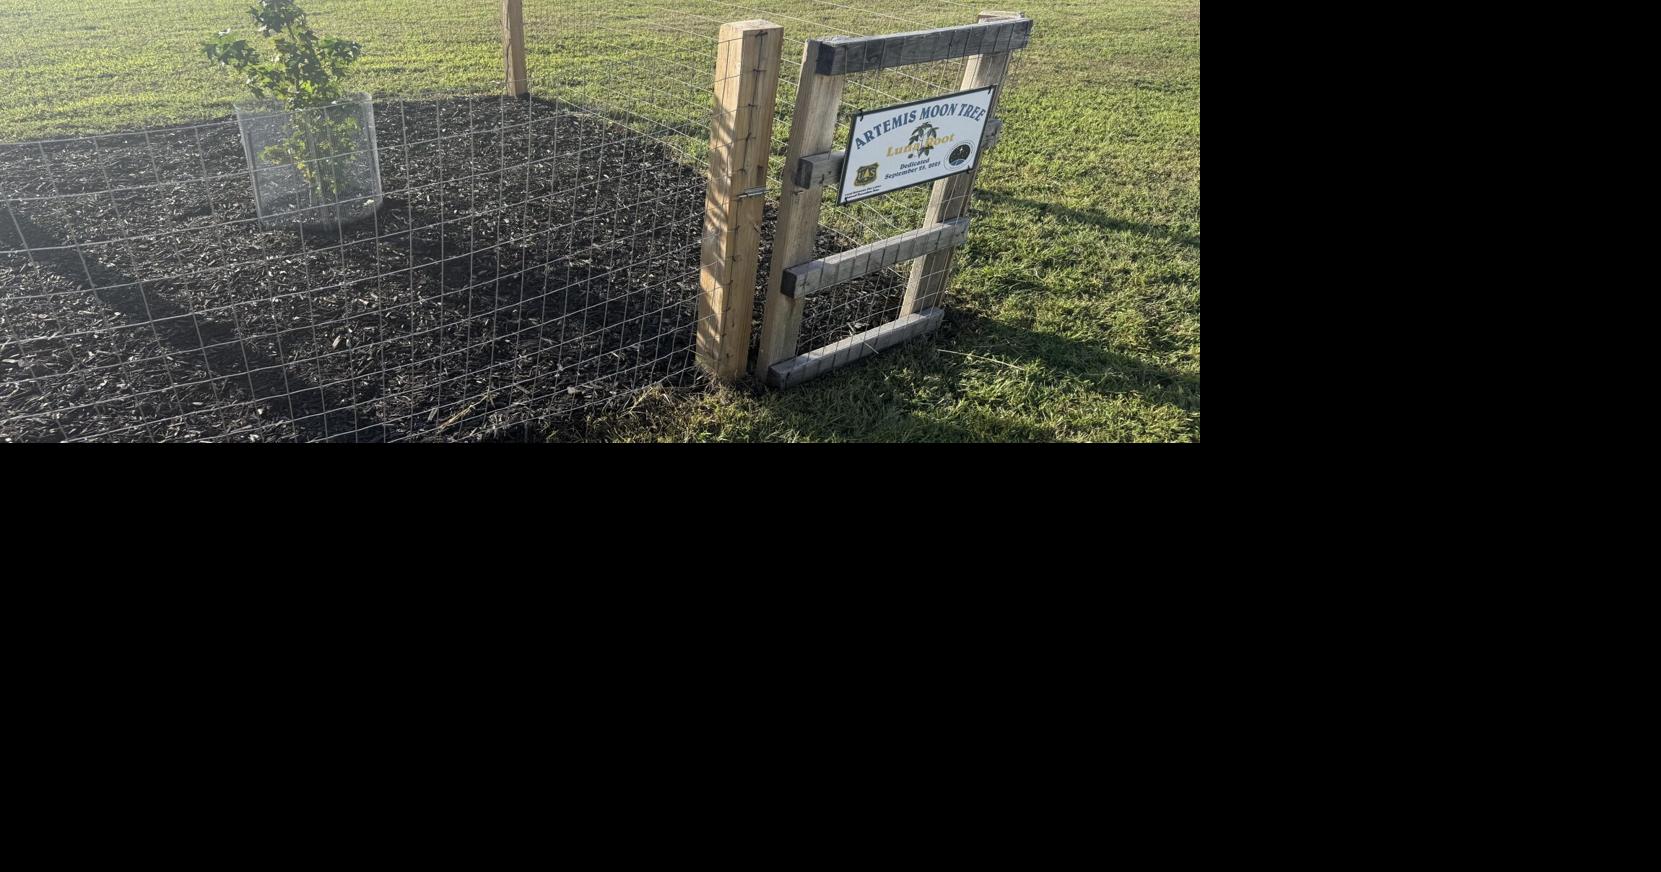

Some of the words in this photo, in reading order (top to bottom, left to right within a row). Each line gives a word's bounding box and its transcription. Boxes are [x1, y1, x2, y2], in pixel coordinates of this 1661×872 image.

[855, 109, 917, 150] ARTEMIS
[919, 103, 958, 121] MOON
[958, 103, 986, 122] TREE
[900, 157, 930, 170] Dedicated
[884, 167, 918, 180] September
